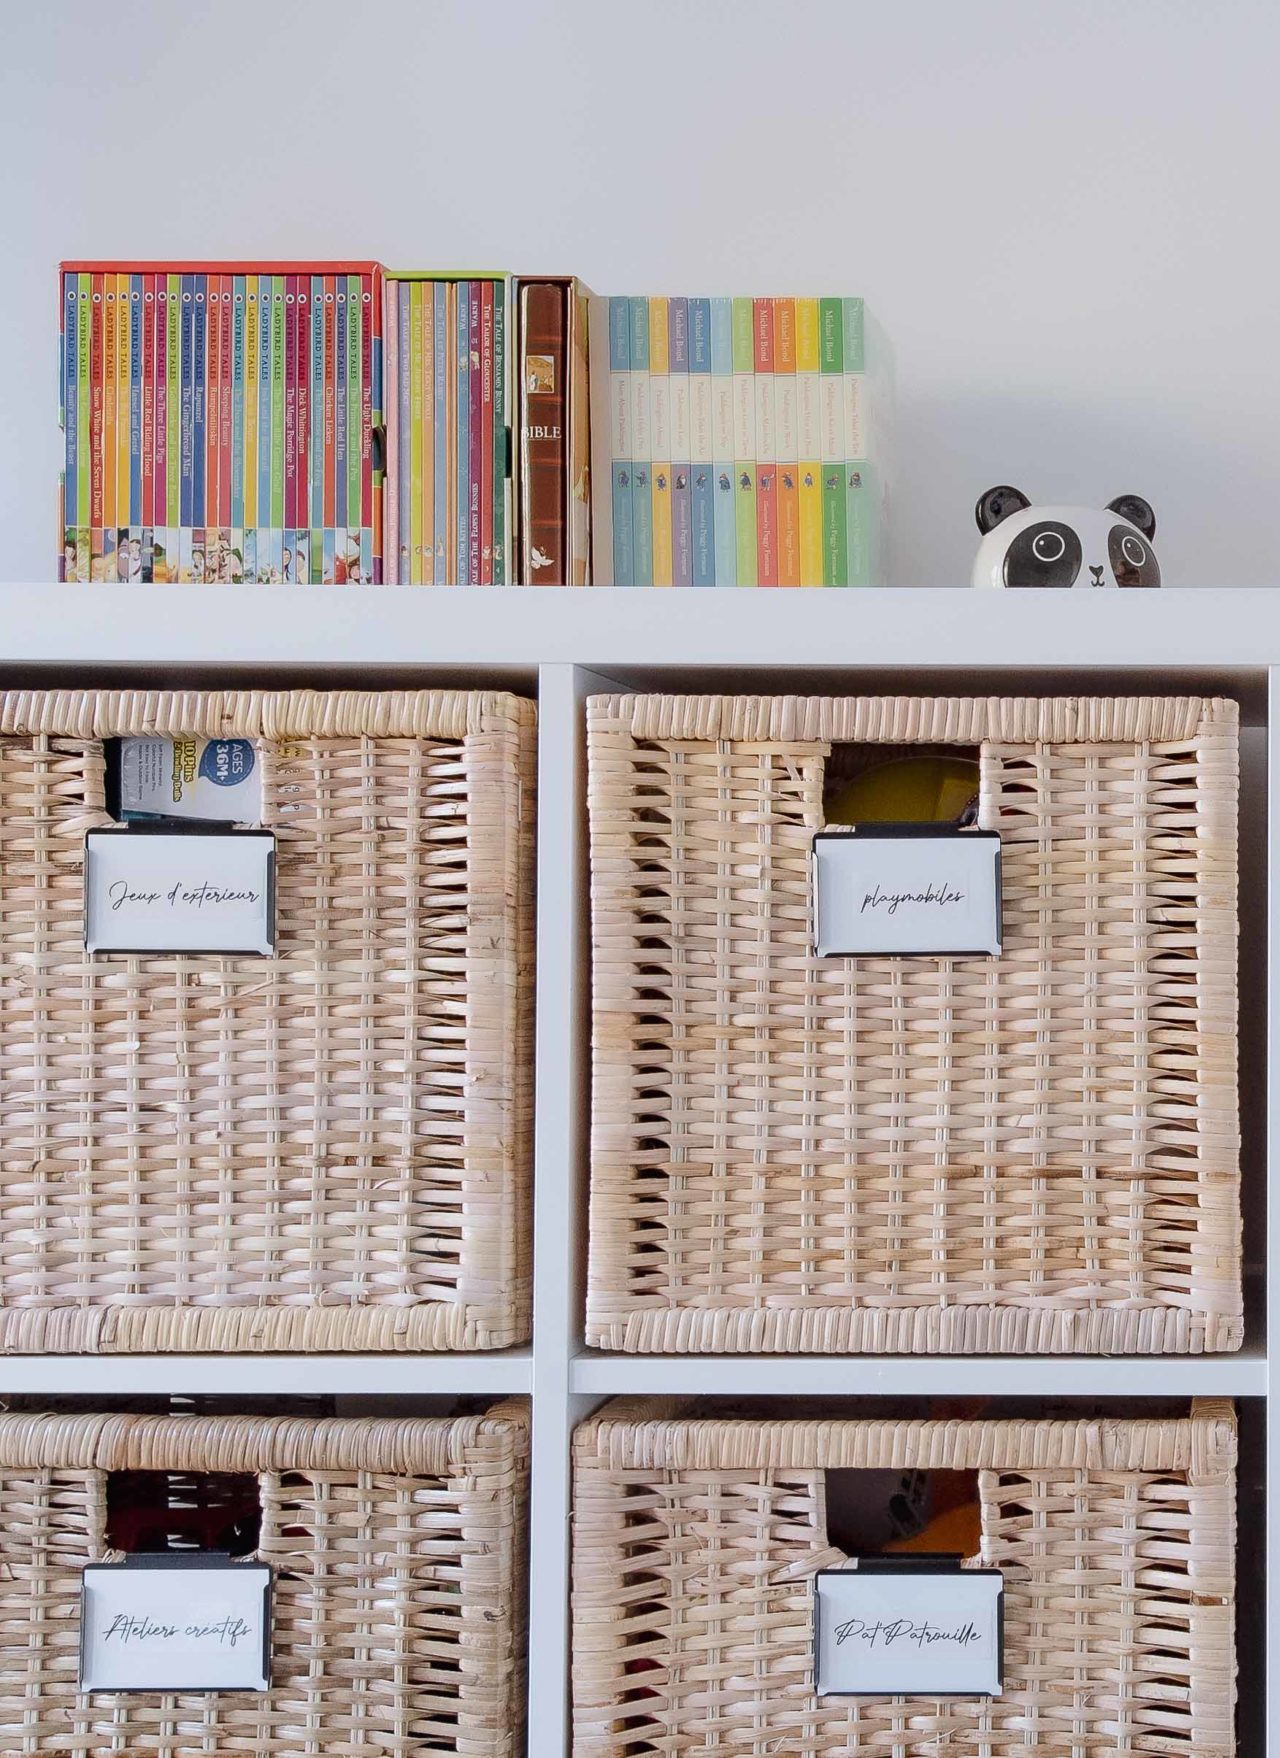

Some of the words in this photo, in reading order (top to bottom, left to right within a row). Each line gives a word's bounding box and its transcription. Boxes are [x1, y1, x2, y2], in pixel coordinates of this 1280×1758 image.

[676, 309, 684, 339] Michael
[694, 310, 704, 342] Michael
[759, 309, 768, 340] Michael
[781, 310, 790, 340] Michael
[825, 310, 834, 340] Michael
[676, 340, 684, 361] Bond
[696, 342, 705, 363] Bond
[760, 341, 769, 362] Bond
[782, 342, 790, 362] Bond
[826, 341, 835, 362] Bond
[93, 386, 101, 408] Snow
[144, 386, 152, 406] Little
[158, 385, 166, 400] The
[183, 386, 191, 402] The
[222, 386, 230, 419] Sleeping
[286, 388, 294, 403] The
[299, 388, 307, 406] Dick
[326, 386, 334, 418] Chicken
[337, 387, 345, 402] The
[363, 386, 371, 401] The
[158, 402, 166, 423] Three
[194, 386, 203, 423] Rapunzel
[337, 404, 345, 424] Little
[362, 403, 371, 423] Ugly
[93, 410, 101, 432] White
[144, 408, 152, 424] Red
[285, 405, 294, 428] Magic
[143, 426, 152, 452] Riding
[158, 425, 166, 446] Little
[181, 404, 191, 456] Gingerbread
[222, 421, 230, 447] Beauty
[298, 408, 307, 454] Whittington
[326, 420, 334, 444] Licken
[337, 426, 345, 442] Red
[522, 425, 562, 439] BIBLE
[93, 435, 101, 449] and
[285, 430, 294, 463] Porridge
[337, 444, 345, 460] Hen
[362, 424, 371, 459] Duckling
[93, 452, 101, 464] the
[144, 454, 152, 476] Hood
[156, 448, 166, 464] Pigs
[93, 466, 101, 488] Seven
[183, 458, 191, 477] Man
[286, 465, 294, 478] Pot
[93, 491, 101, 519] Dwarfs
[216, 744, 229, 781] 36M+
[232, 743, 243, 774] AGES
[108, 880, 161, 910] Jeux
[861, 882, 966, 915] playmobiles
[102, 1613, 180, 1644] Ateliers
